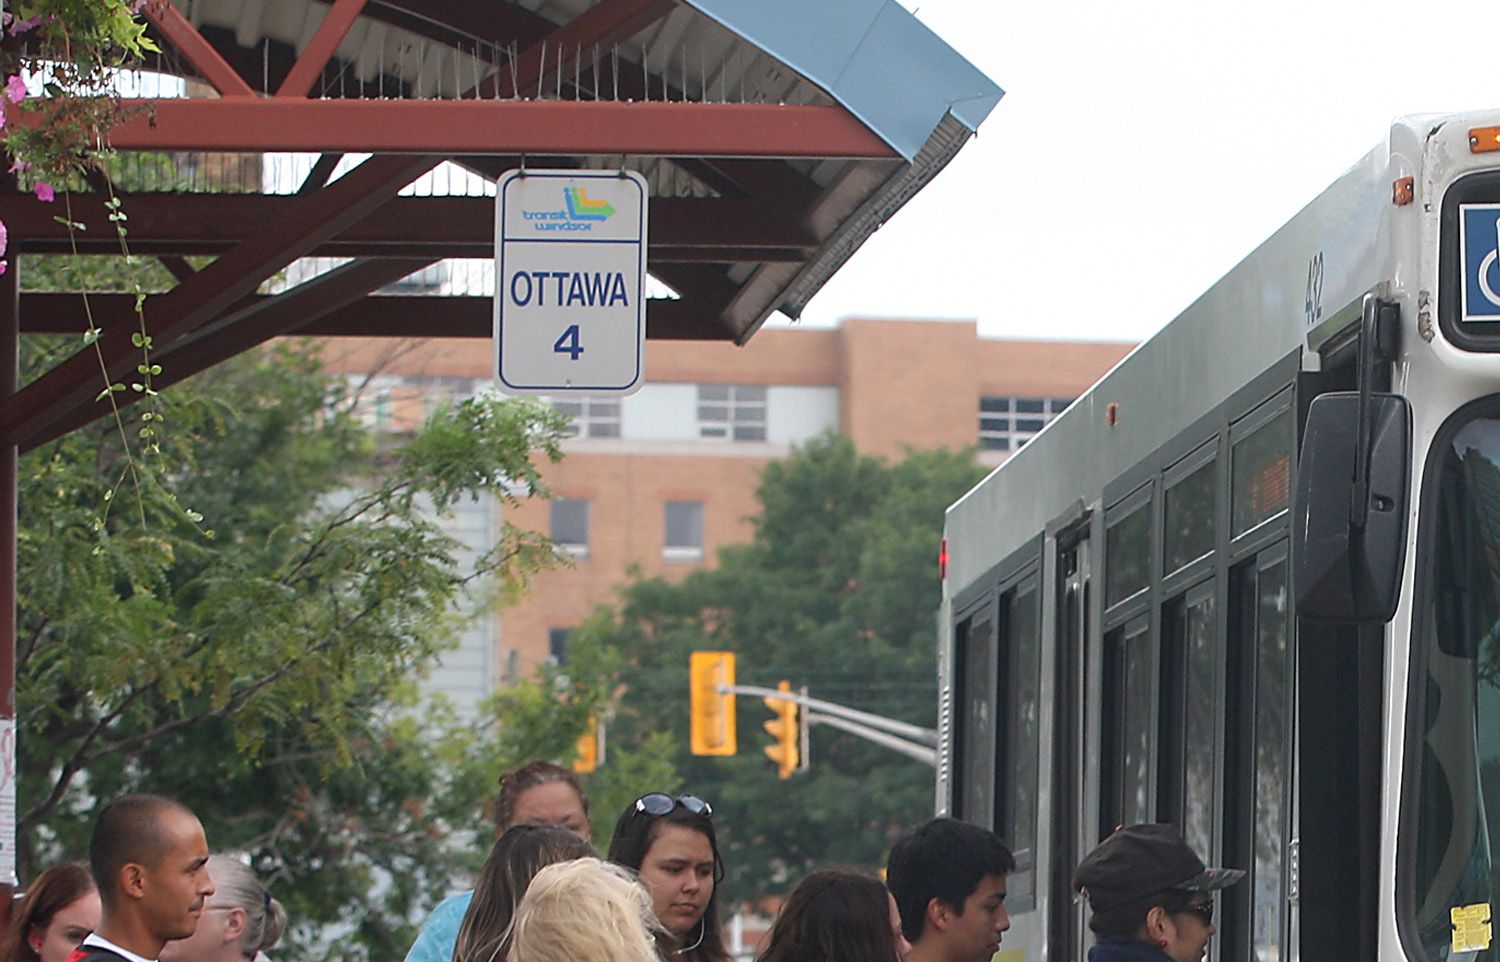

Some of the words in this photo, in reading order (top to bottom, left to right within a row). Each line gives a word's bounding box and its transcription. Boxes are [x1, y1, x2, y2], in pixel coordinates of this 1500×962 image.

[522, 210, 569, 220] transit
[535, 221, 592, 231] windsor
[510, 271, 628, 307] OTTAWA
[553, 325, 585, 361] 4
